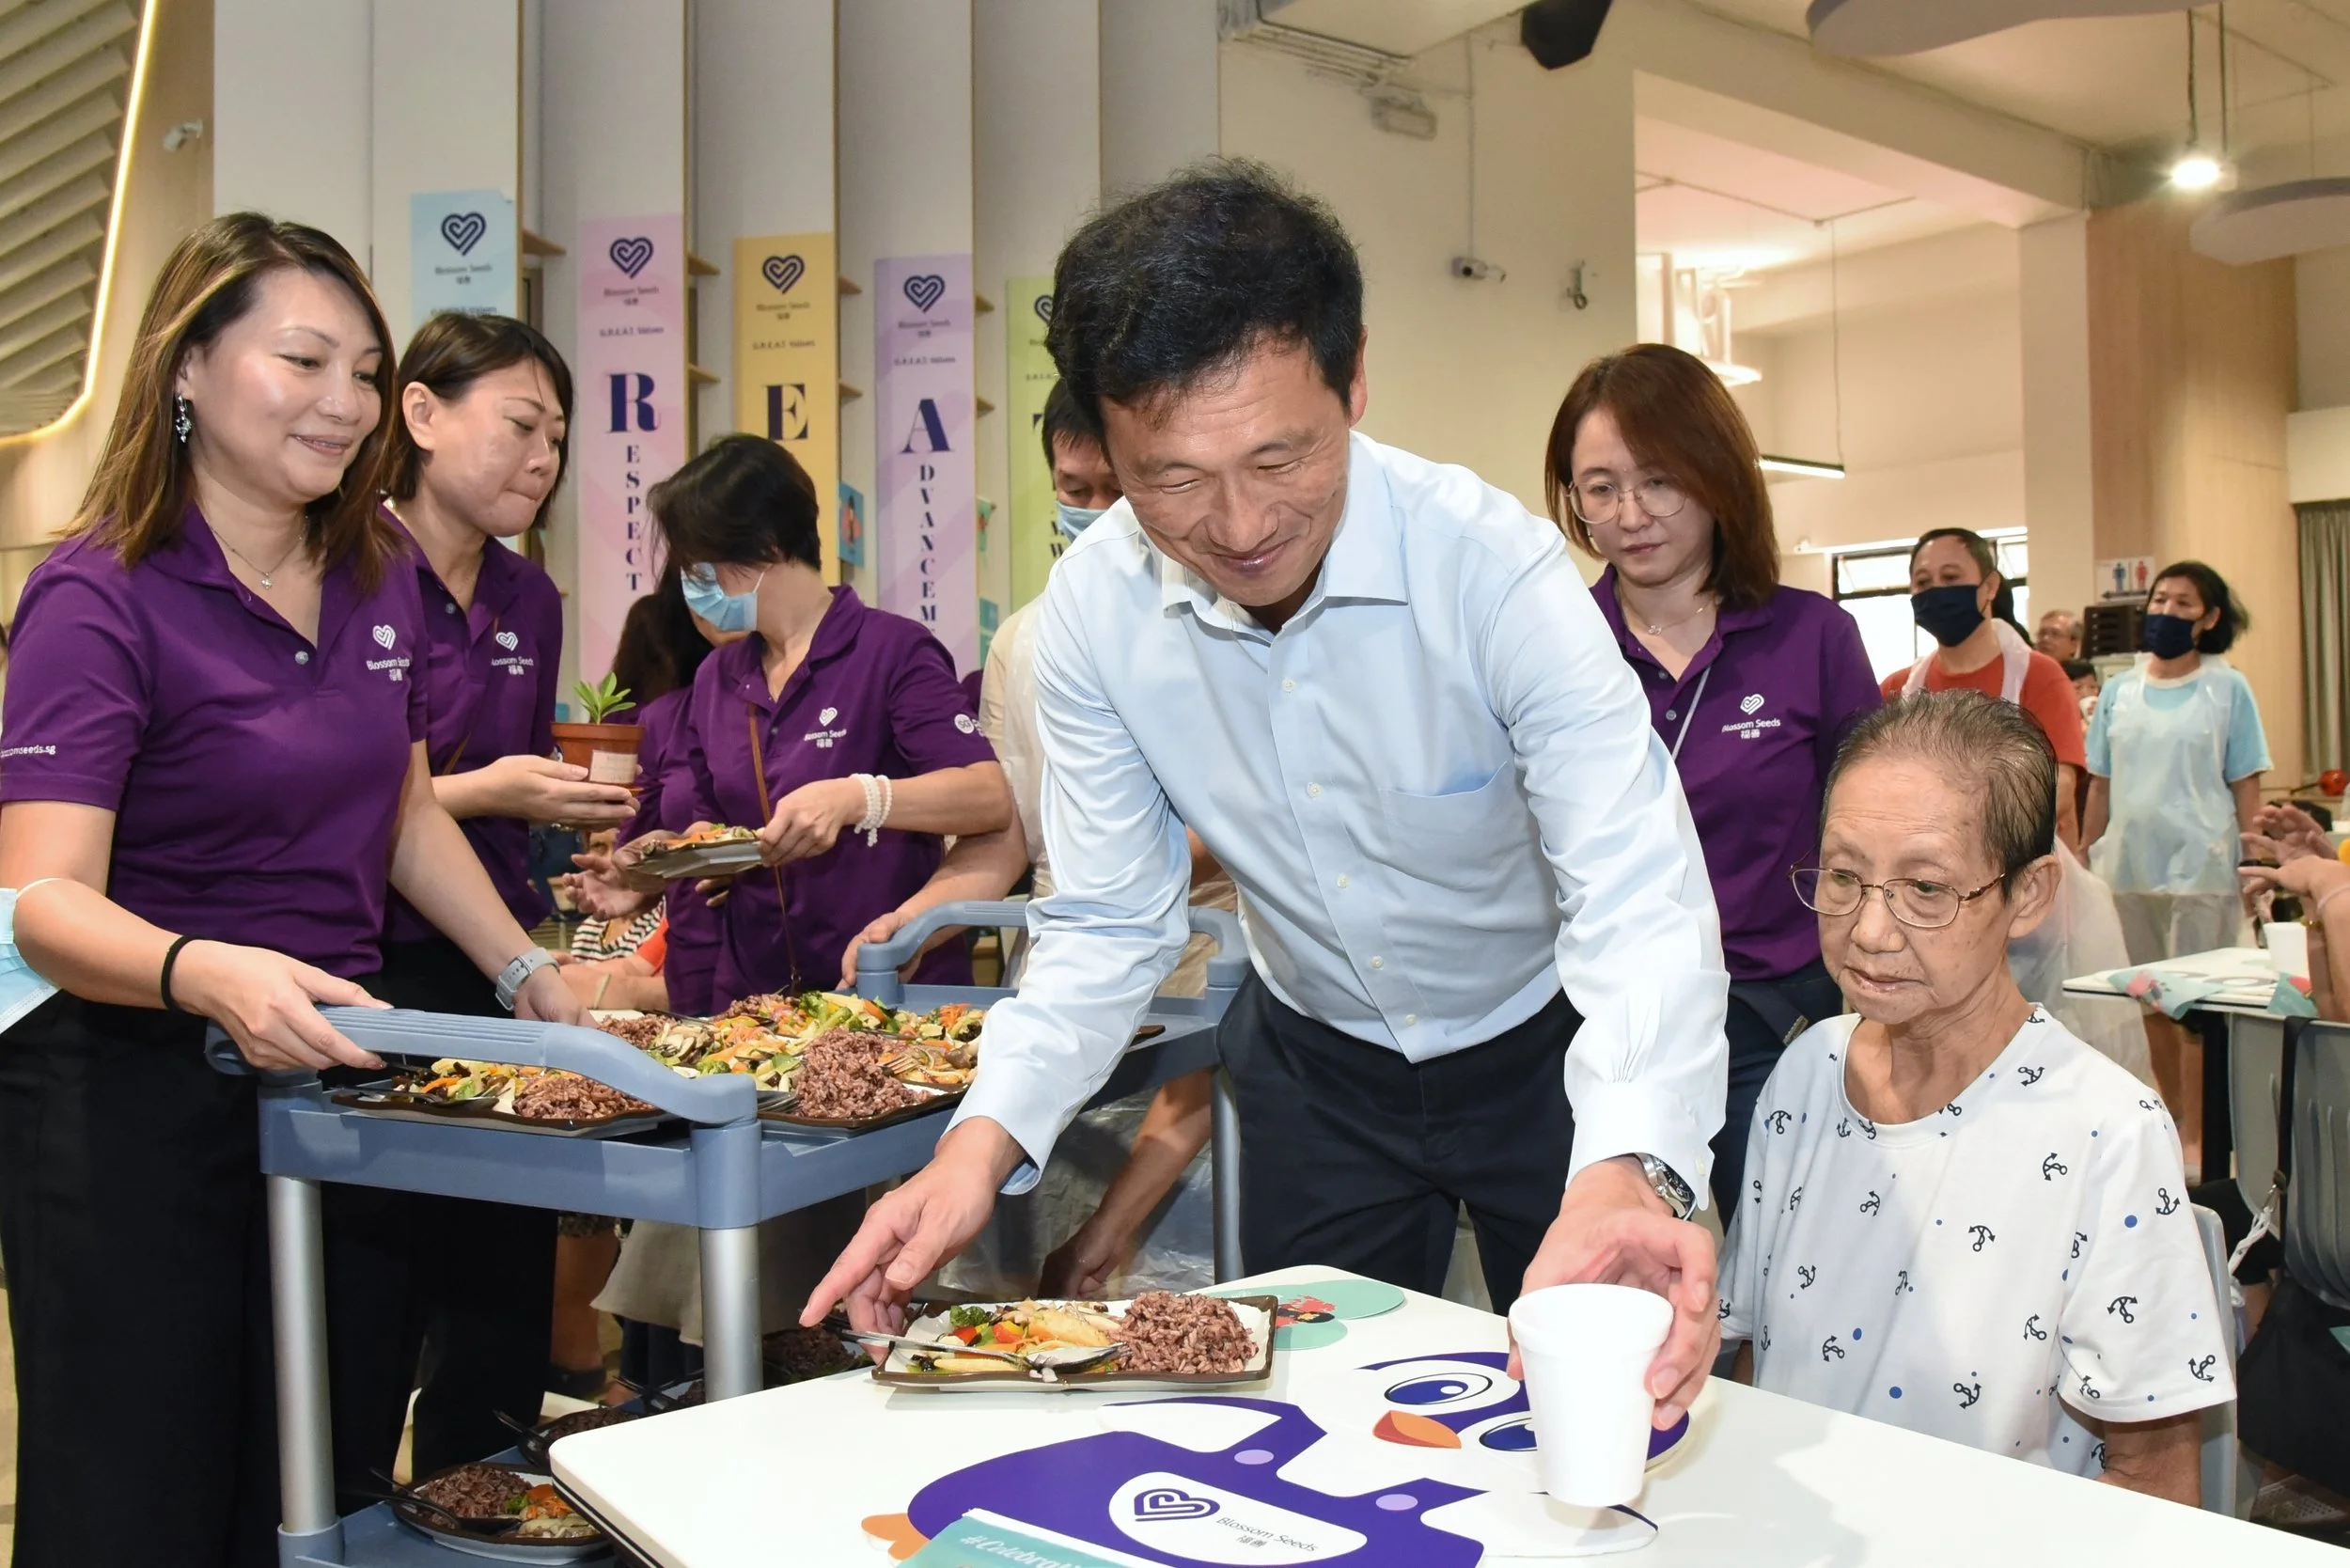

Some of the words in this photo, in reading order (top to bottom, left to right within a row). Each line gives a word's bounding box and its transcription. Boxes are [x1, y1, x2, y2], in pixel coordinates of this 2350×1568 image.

[898, 398, 953, 632] ADVANCEM
[366, 659, 398, 670] Blossom
[491, 657, 517, 666] lossom
[1722, 721, 1754, 733] Blossom
[1755, 718, 1781, 728] Seeds
[1216, 1516, 1275, 1539] Blossom
[1274, 1533, 1318, 1552] Seeds
